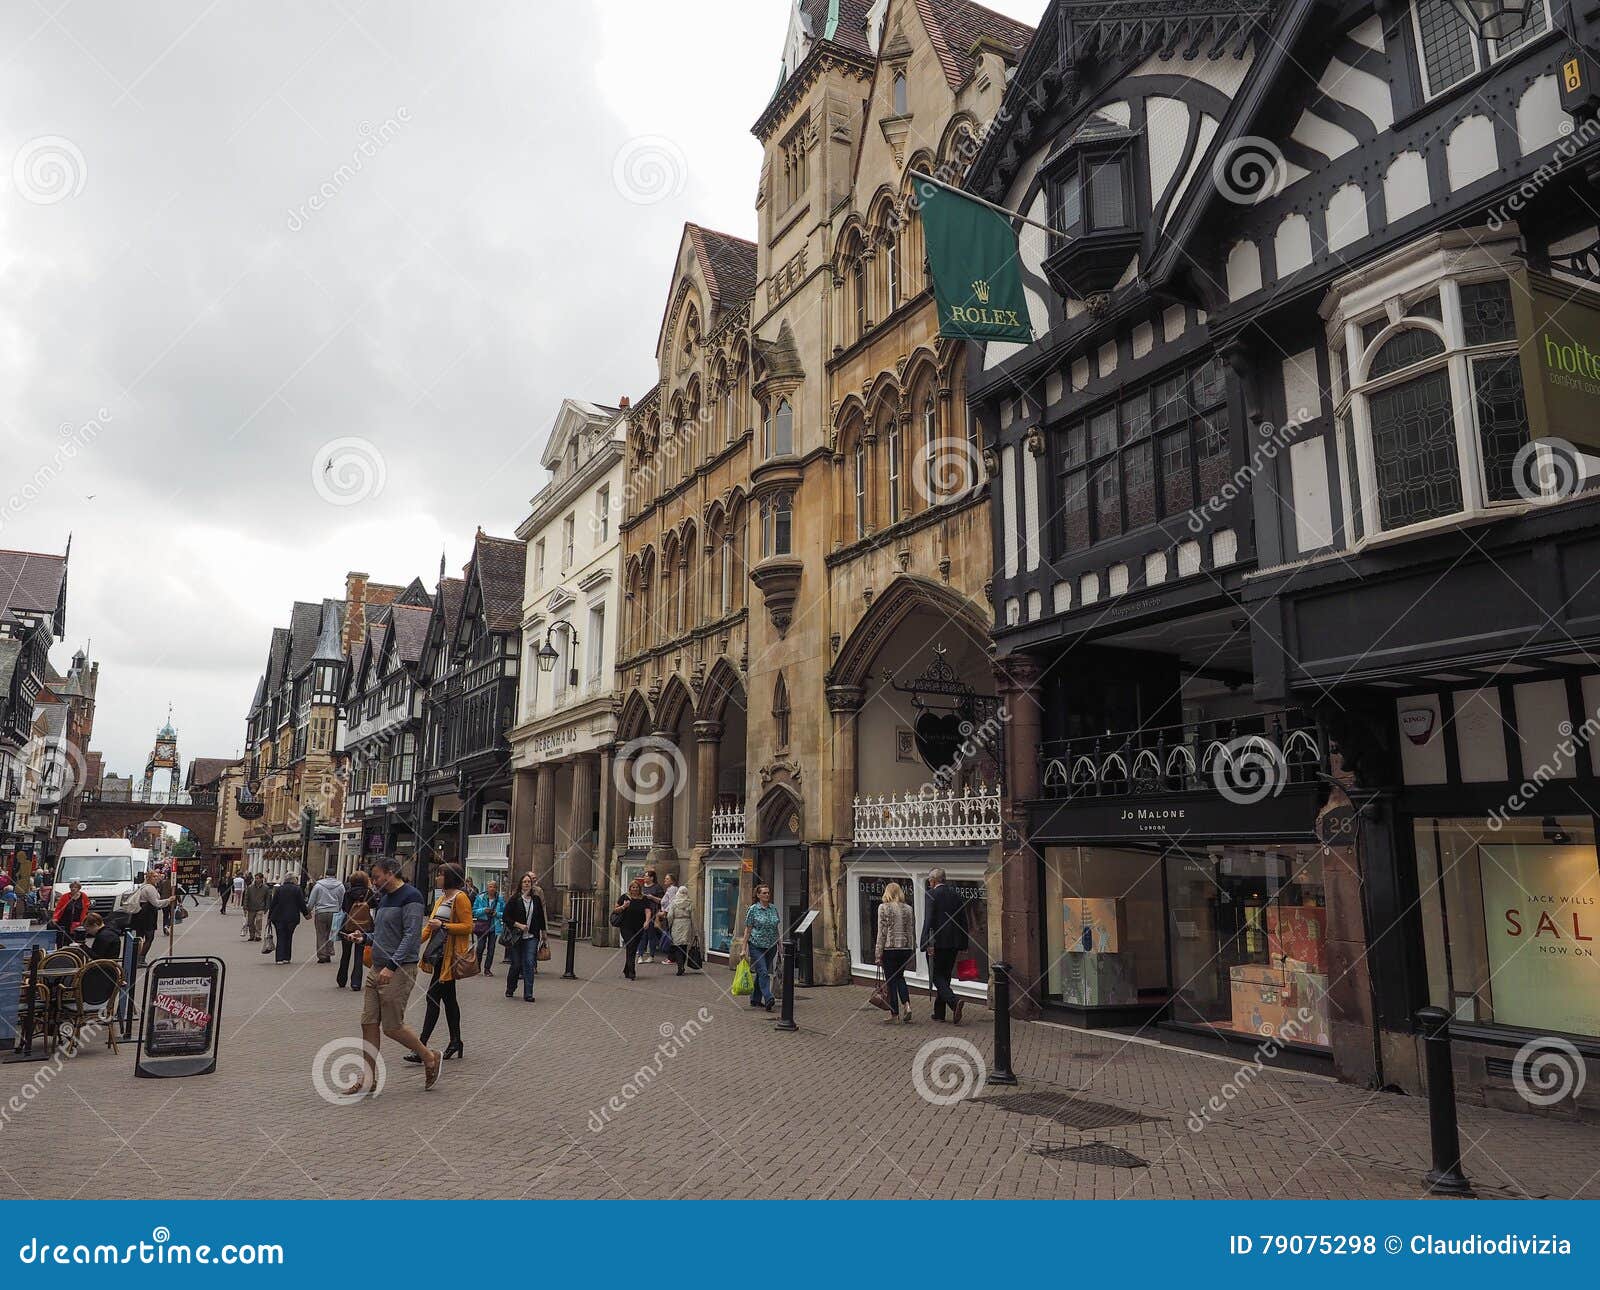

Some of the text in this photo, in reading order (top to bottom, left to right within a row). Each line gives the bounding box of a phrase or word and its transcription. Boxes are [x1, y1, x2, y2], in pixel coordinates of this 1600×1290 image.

[951, 305, 1021, 327] ROLEX
[534, 727, 577, 753] DEBENHAMS
[1137, 809, 1185, 819] MALONE
[860, 882, 913, 896] DEBENMS
[1528, 895, 1594, 905] JACK WILLS
[1539, 945, 1592, 956] NOW ON
[159, 977, 200, 986] and albert
[153, 994, 176, 1012] SALE
